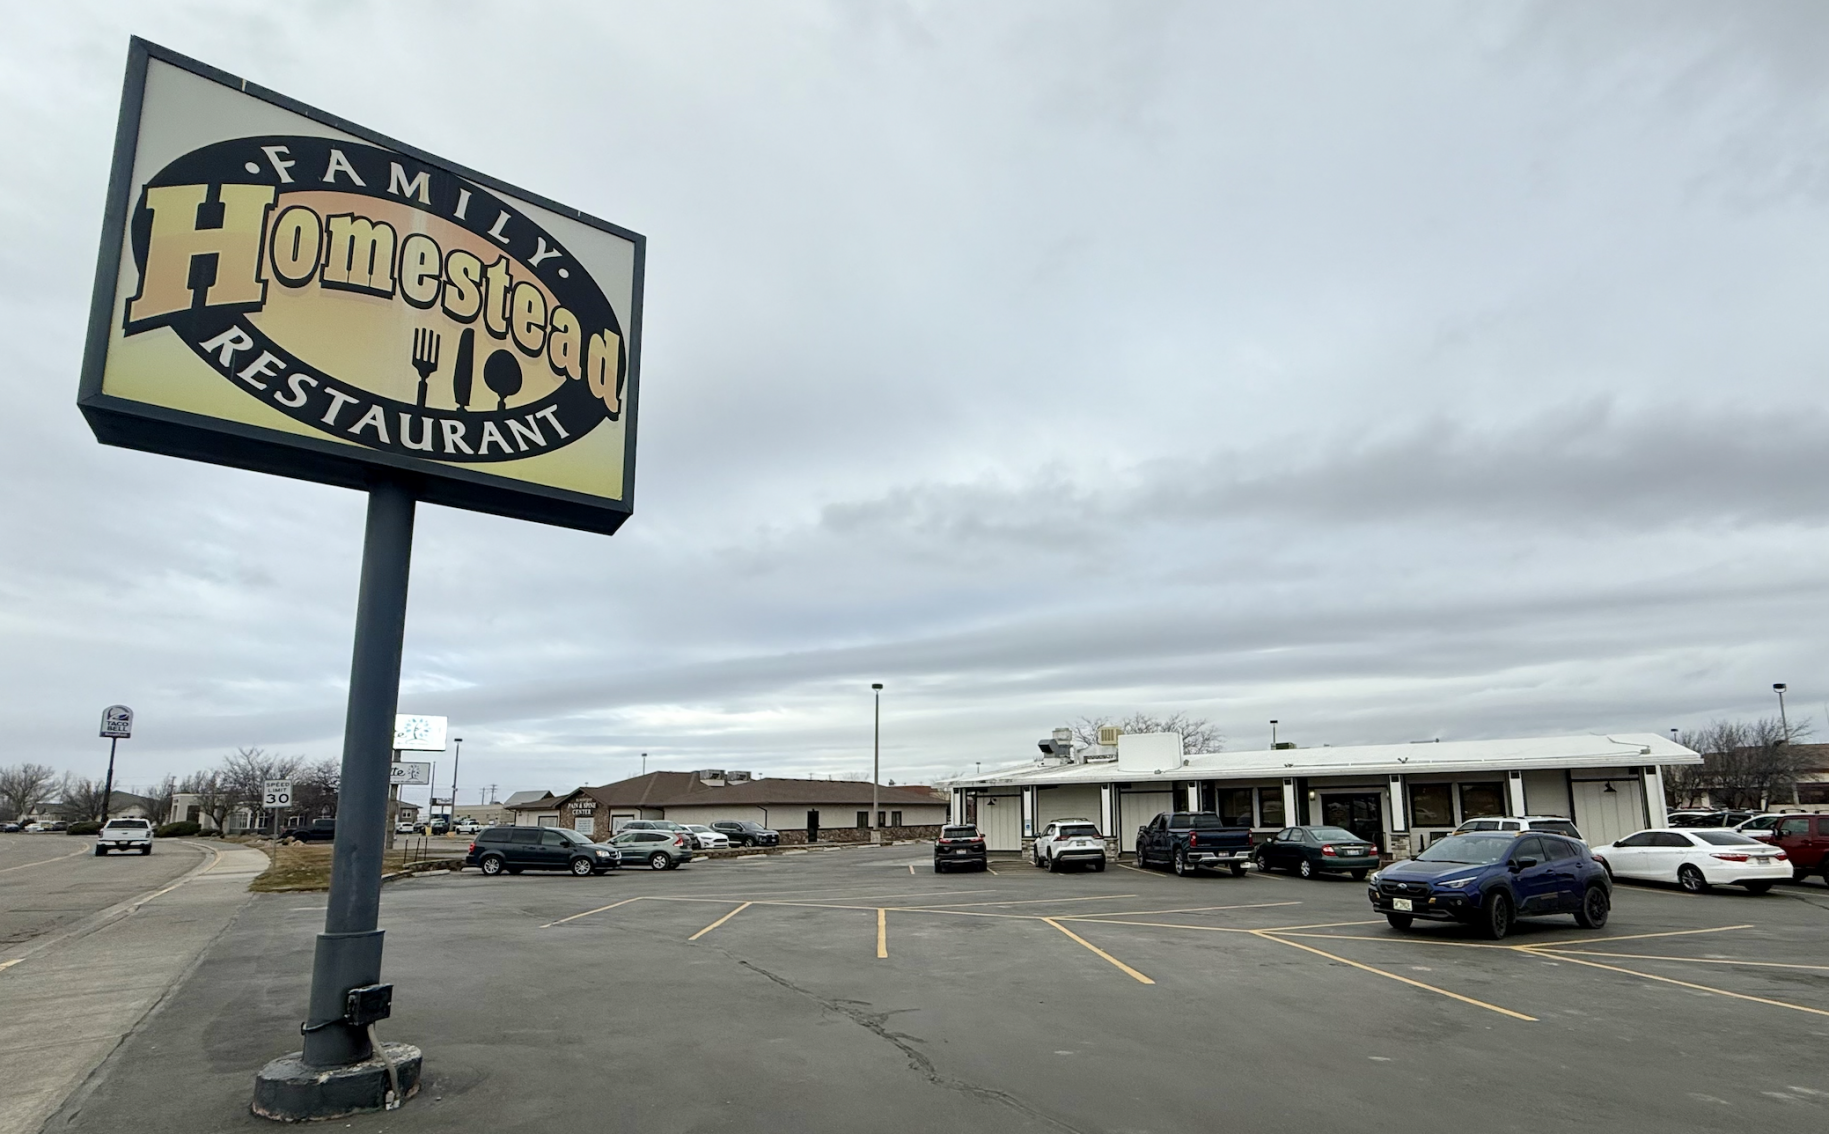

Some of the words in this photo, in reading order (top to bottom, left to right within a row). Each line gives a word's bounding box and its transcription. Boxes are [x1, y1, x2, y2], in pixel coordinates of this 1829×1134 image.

[260, 145, 562, 265] FAMILY
[124, 183, 622, 421] Homestead
[199, 324, 572, 456] RESTAURANT
[266, 793, 290, 804] 30
